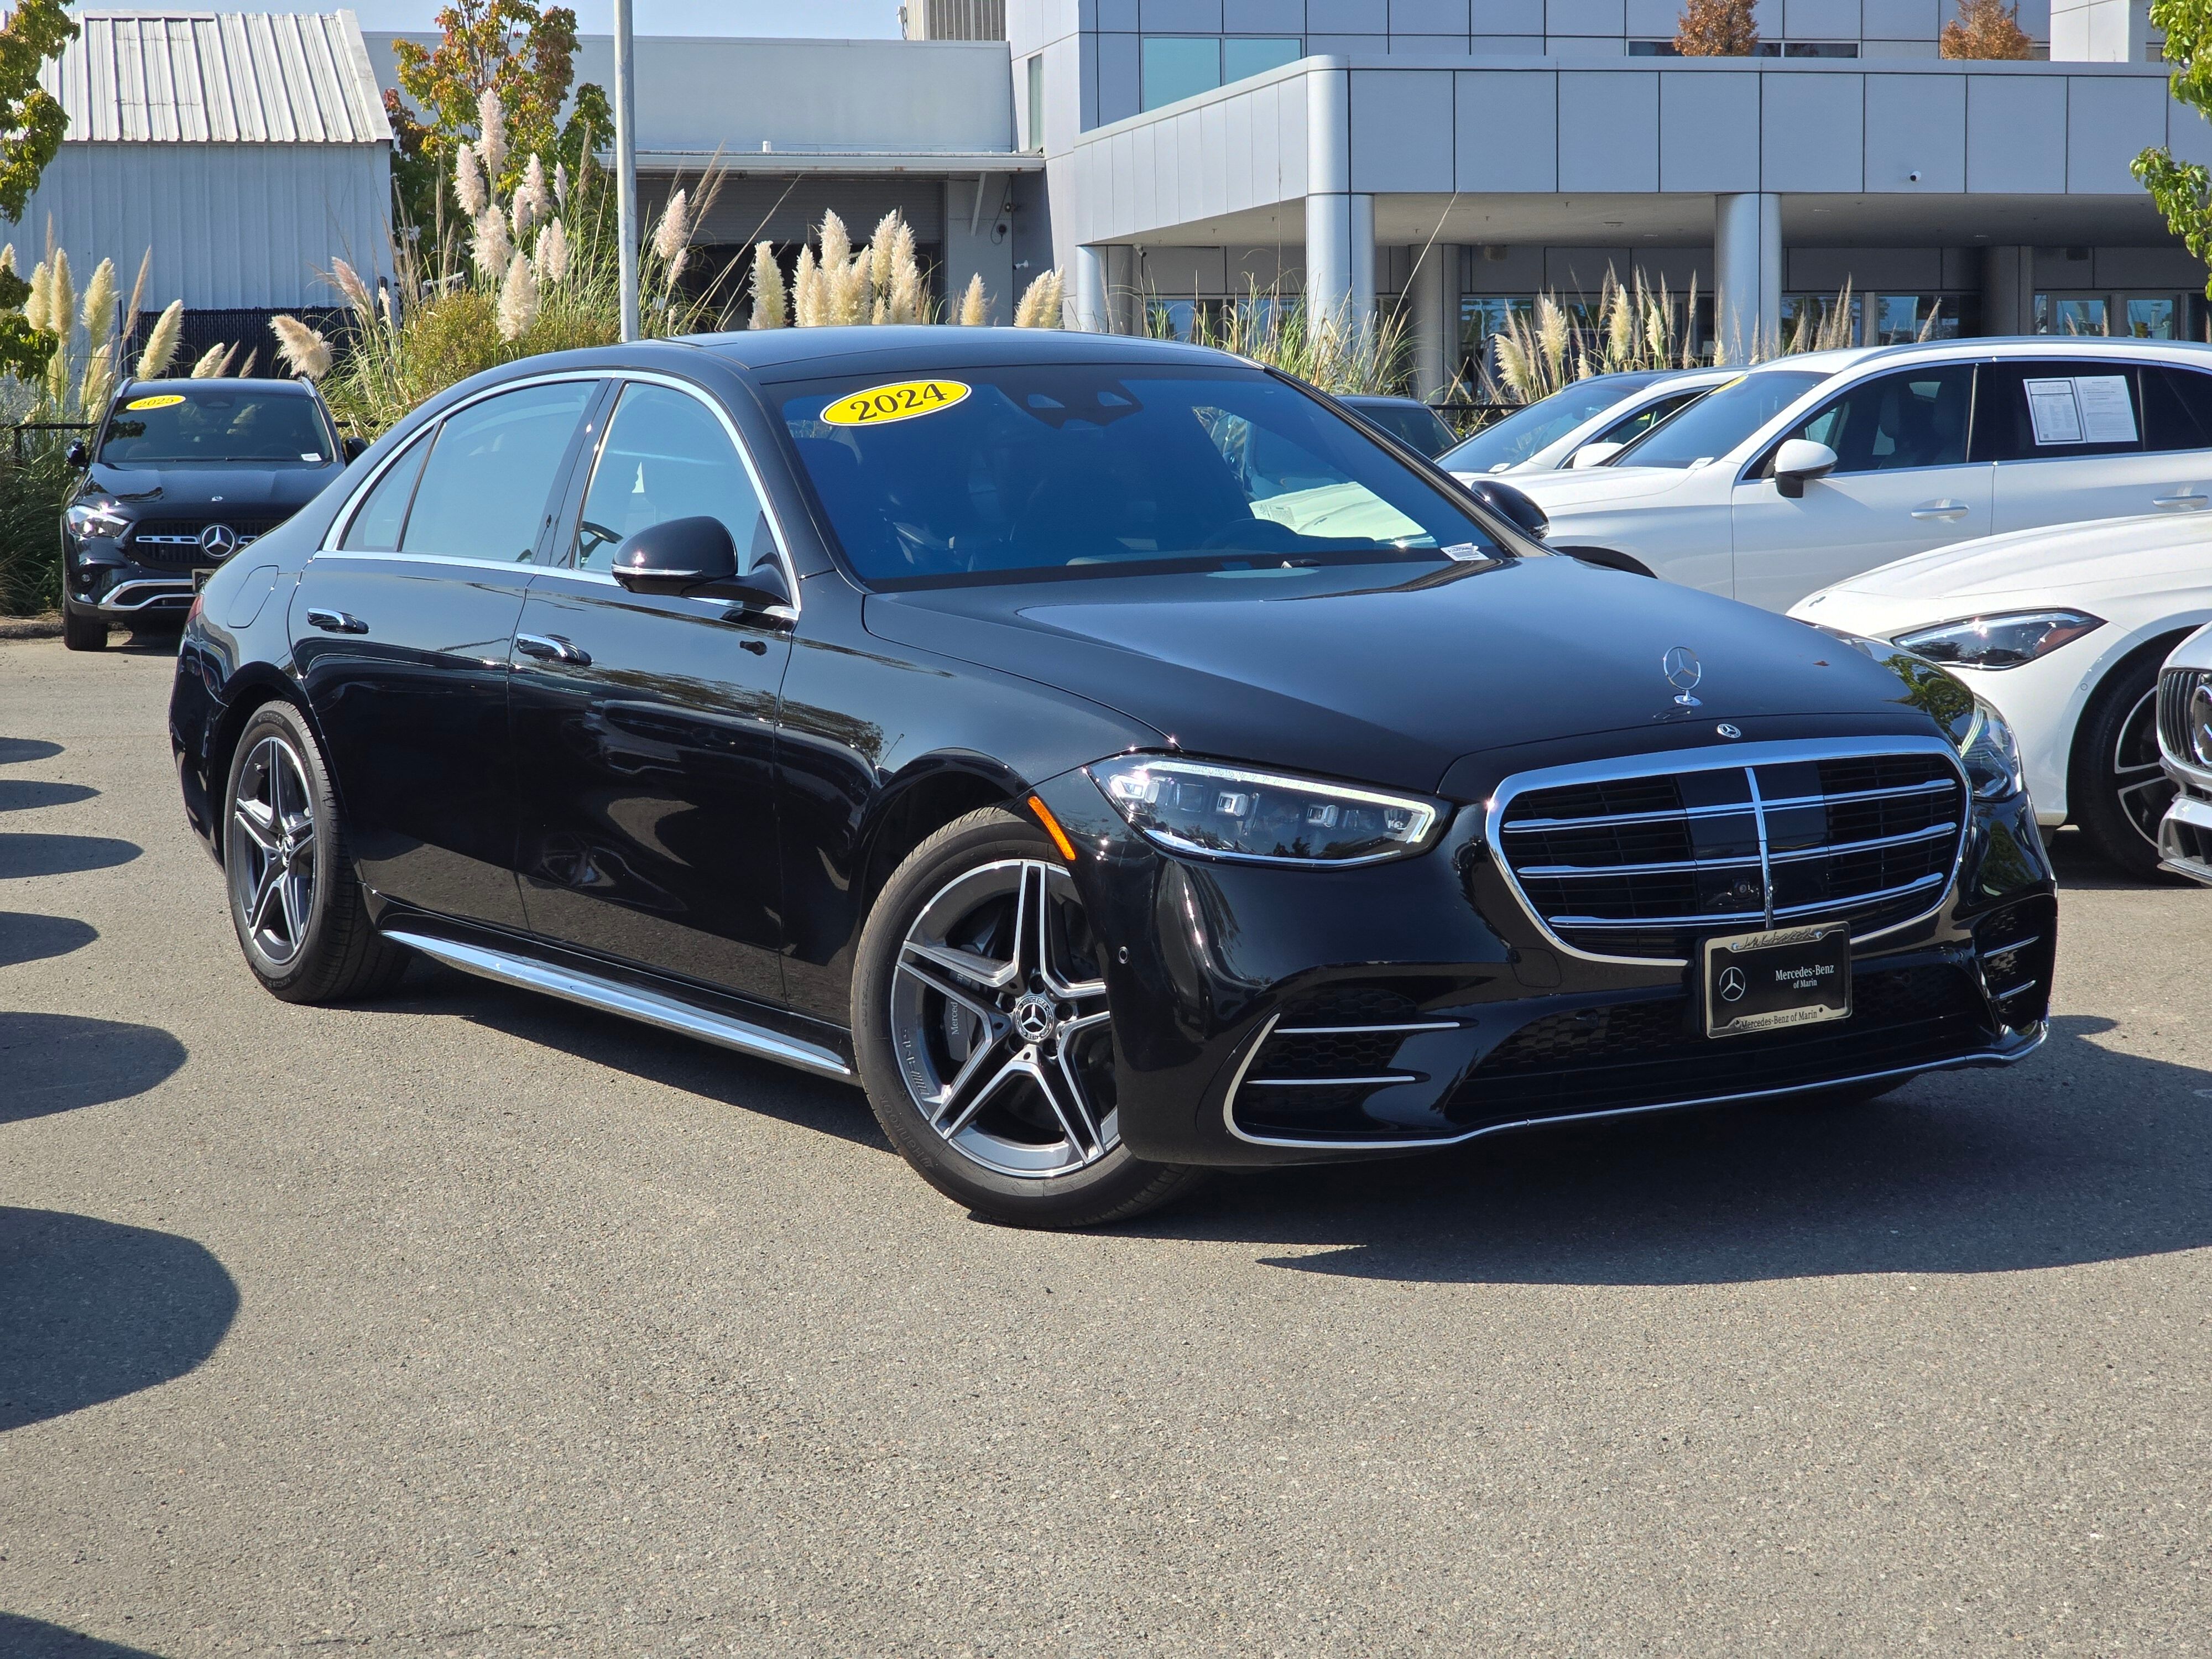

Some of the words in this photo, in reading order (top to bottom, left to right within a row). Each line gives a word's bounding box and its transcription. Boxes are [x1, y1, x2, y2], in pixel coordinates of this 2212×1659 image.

[138, 397, 174, 408] 2025
[850, 383, 948, 421] 2024
[1775, 964, 1834, 981] Mercedes-Benz
[1793, 980, 1800, 989] of
[1800, 978, 1818, 988] Marin
[1741, 1014, 1790, 1030] Mercedes-Benz
[1791, 1013, 1798, 1022] of
[1798, 1010, 1818, 1020] Marin
